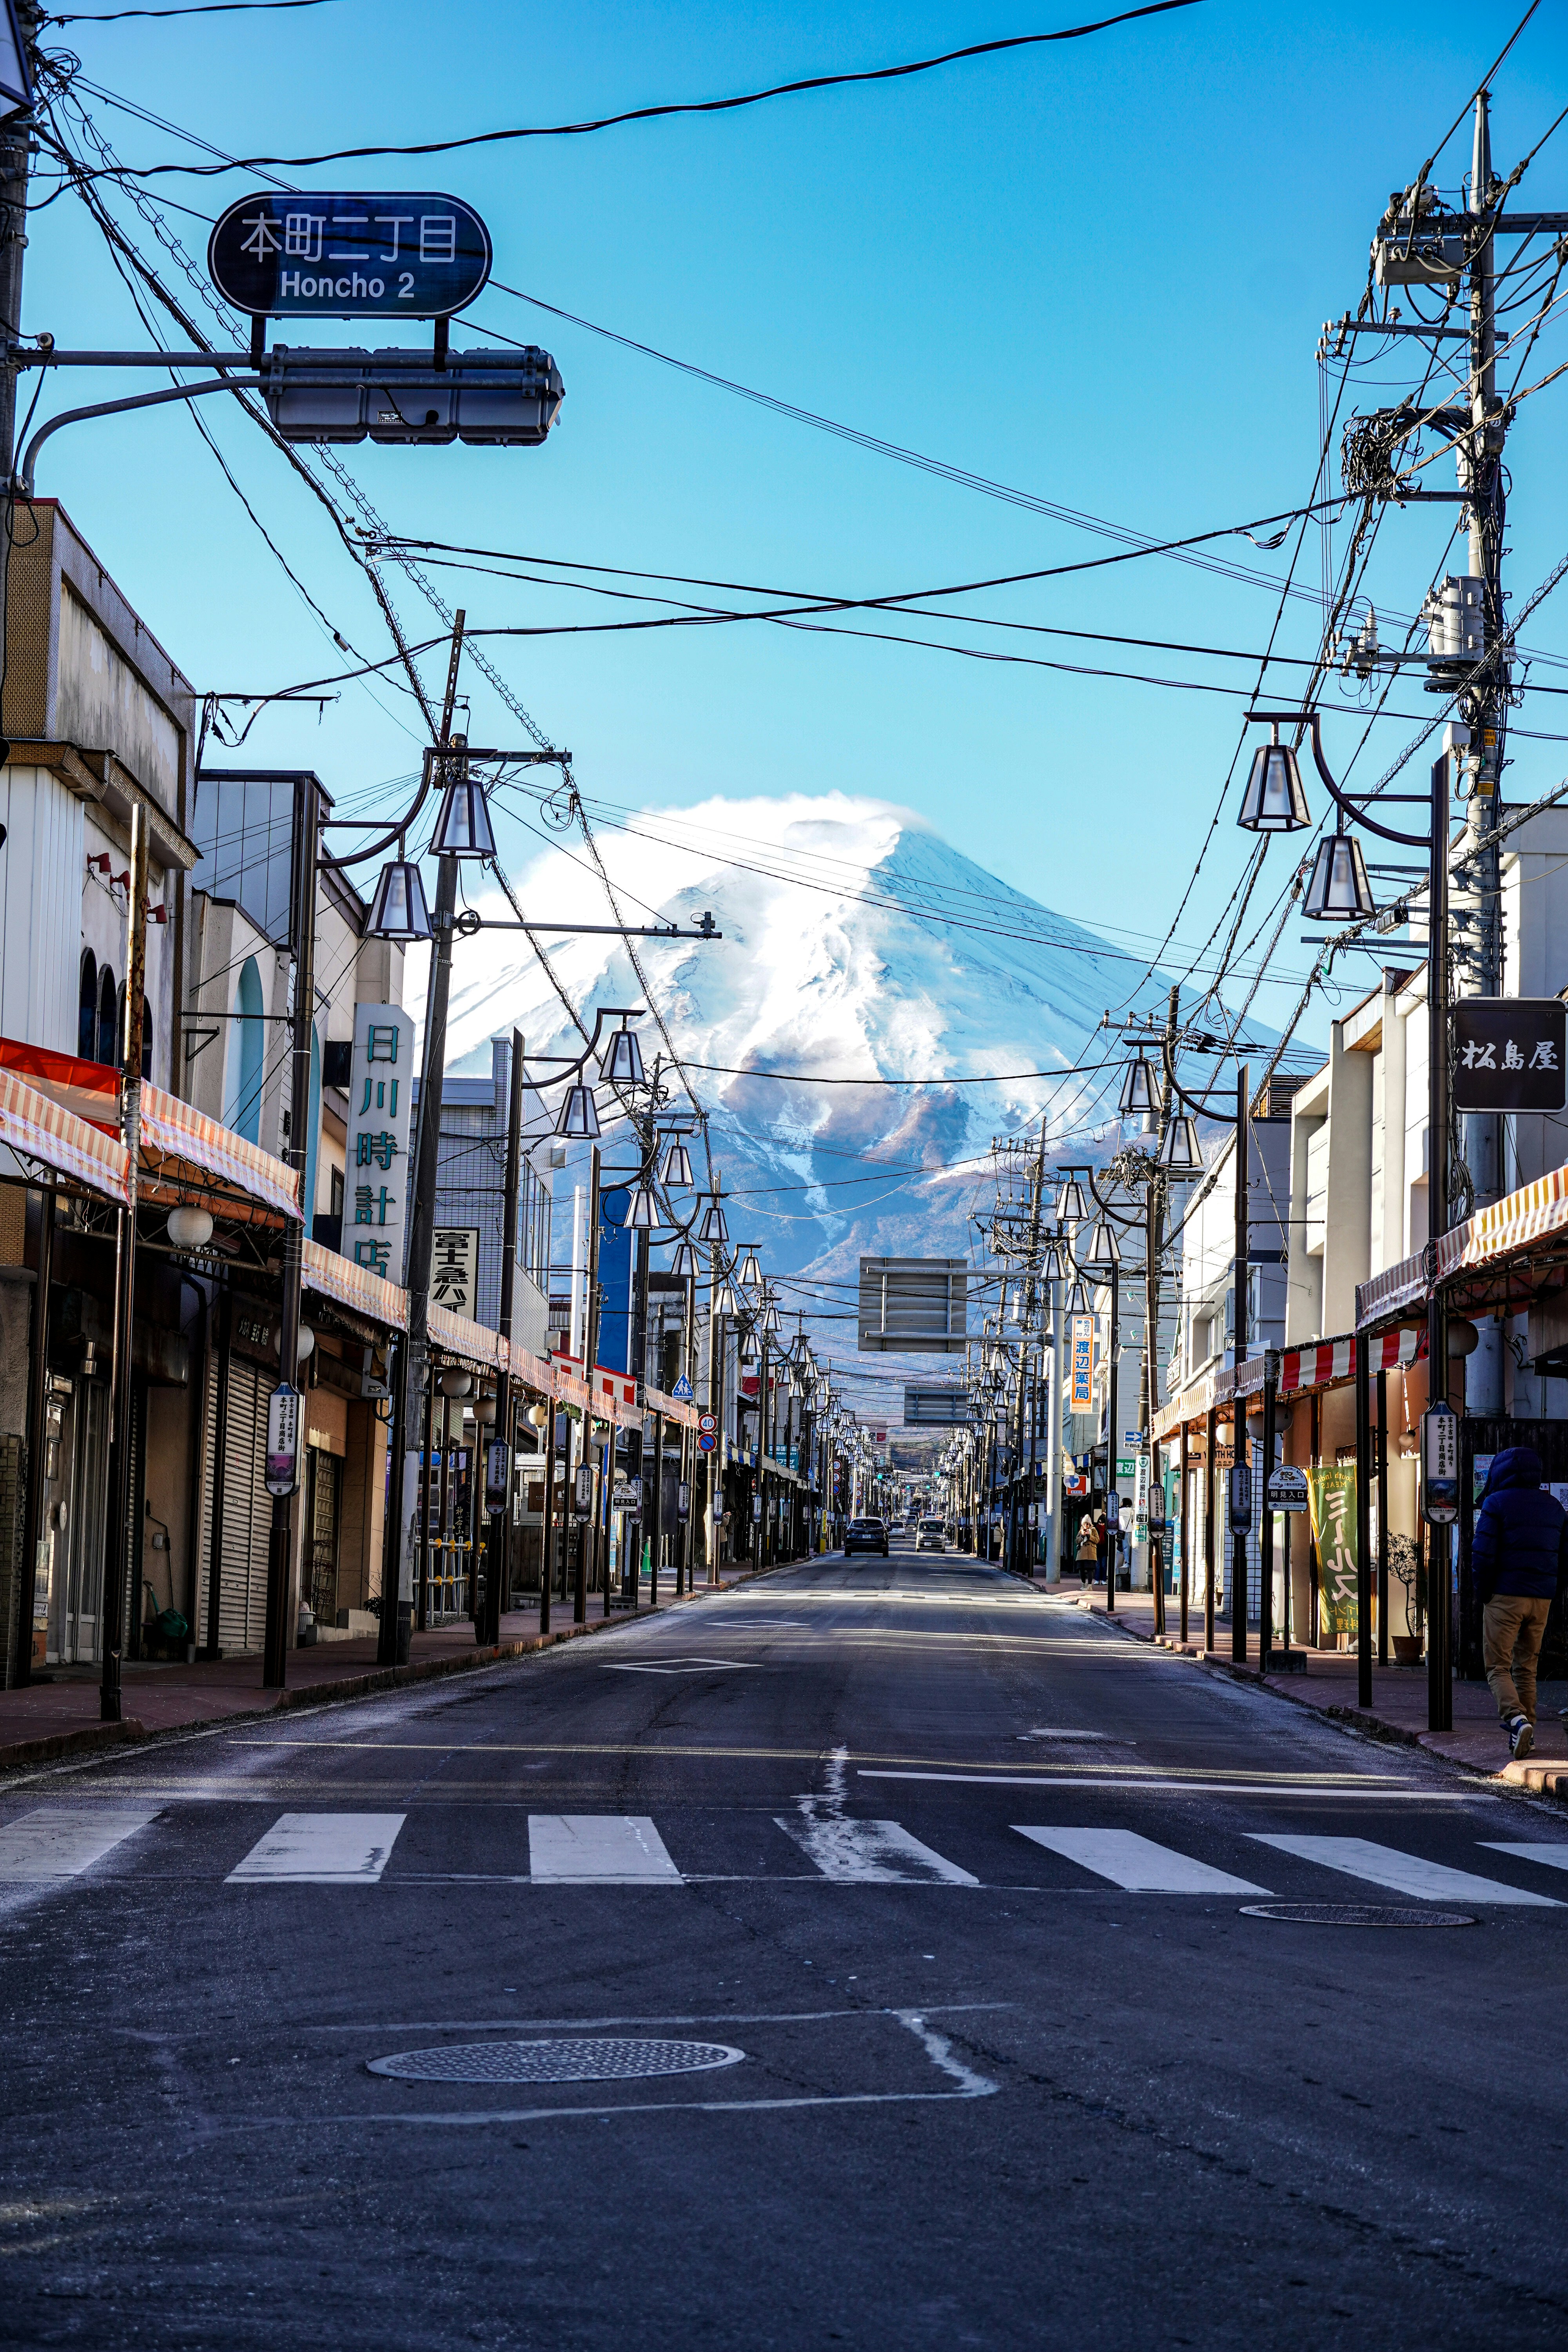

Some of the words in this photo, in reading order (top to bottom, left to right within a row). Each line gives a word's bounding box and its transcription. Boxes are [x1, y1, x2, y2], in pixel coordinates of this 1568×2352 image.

[240, 212, 457, 263] 本町二丁目
[281, 271, 385, 298] Honcho
[397, 272, 415, 298] 2
[1461, 1039, 1559, 1070] 松島屋
[354, 1024, 400, 1279] 日川時計店
[1074, 1341, 1090, 1399] 渡辺薬局
[278, 1396, 288, 1452] 本町二丁目商店街
[702, 1419, 713, 1427] 40
[1437, 1416, 1446, 1476] 本町二丁目商店街
